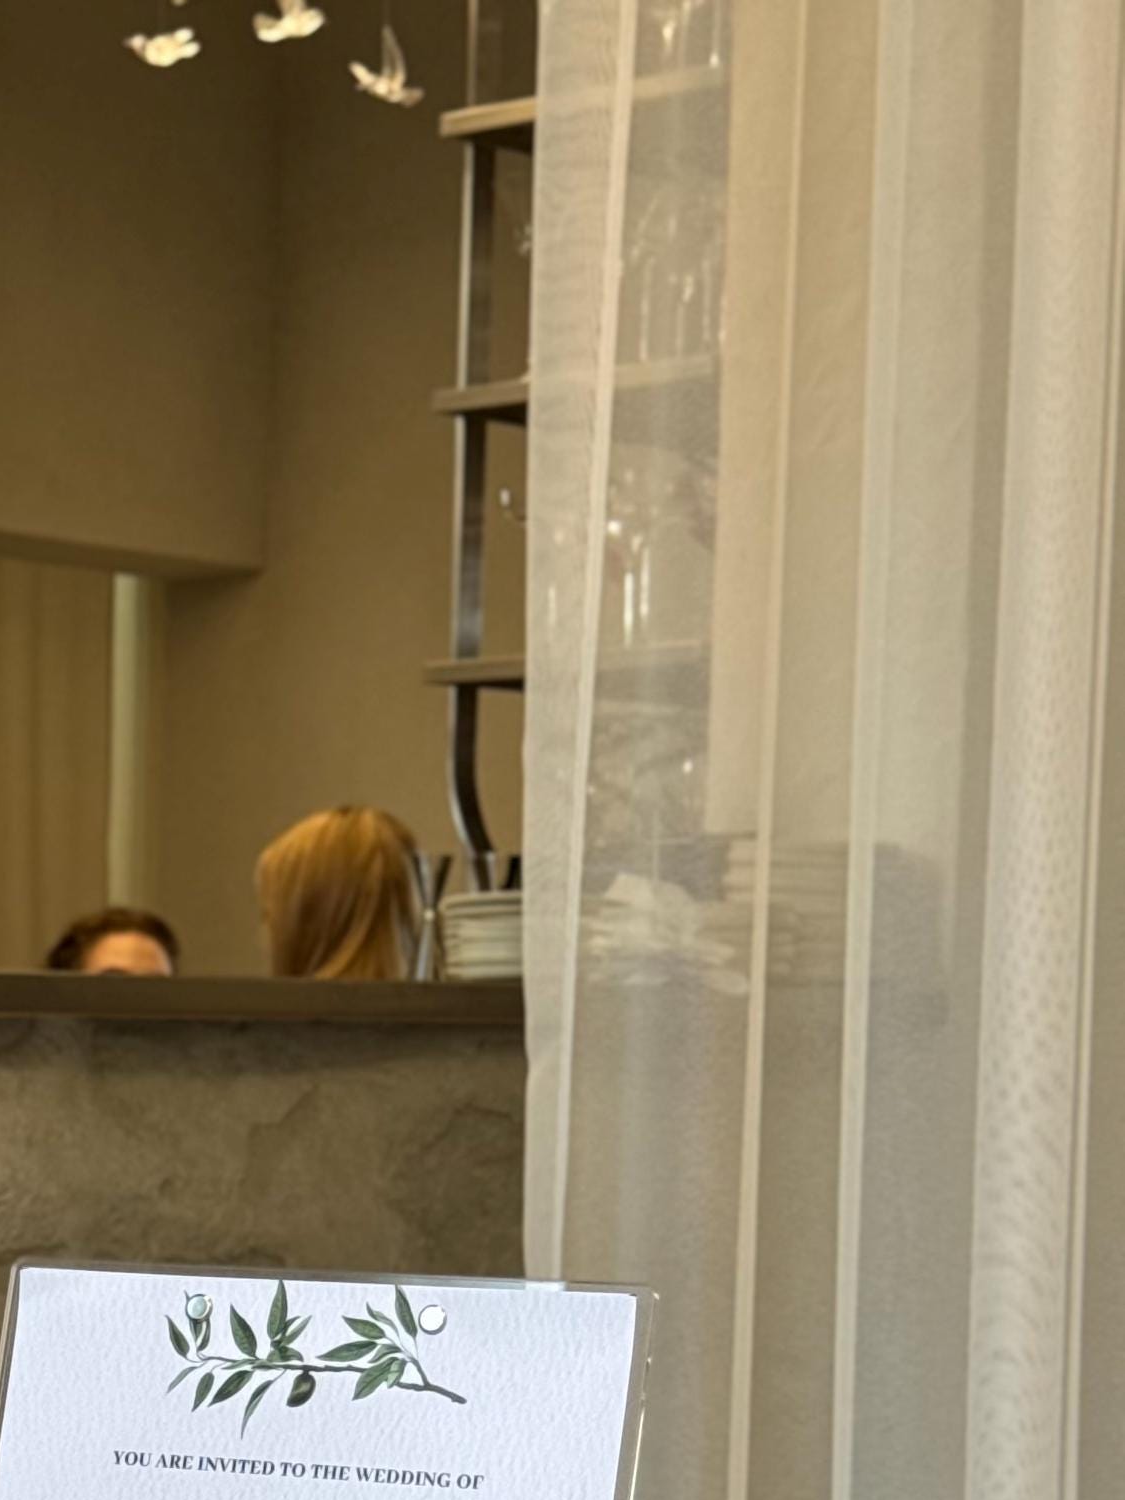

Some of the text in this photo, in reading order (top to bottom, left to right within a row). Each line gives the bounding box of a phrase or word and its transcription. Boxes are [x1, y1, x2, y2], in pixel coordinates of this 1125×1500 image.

[113, 1450, 485, 1490] YOU ARE INVITED TO THE WEDDING OF
